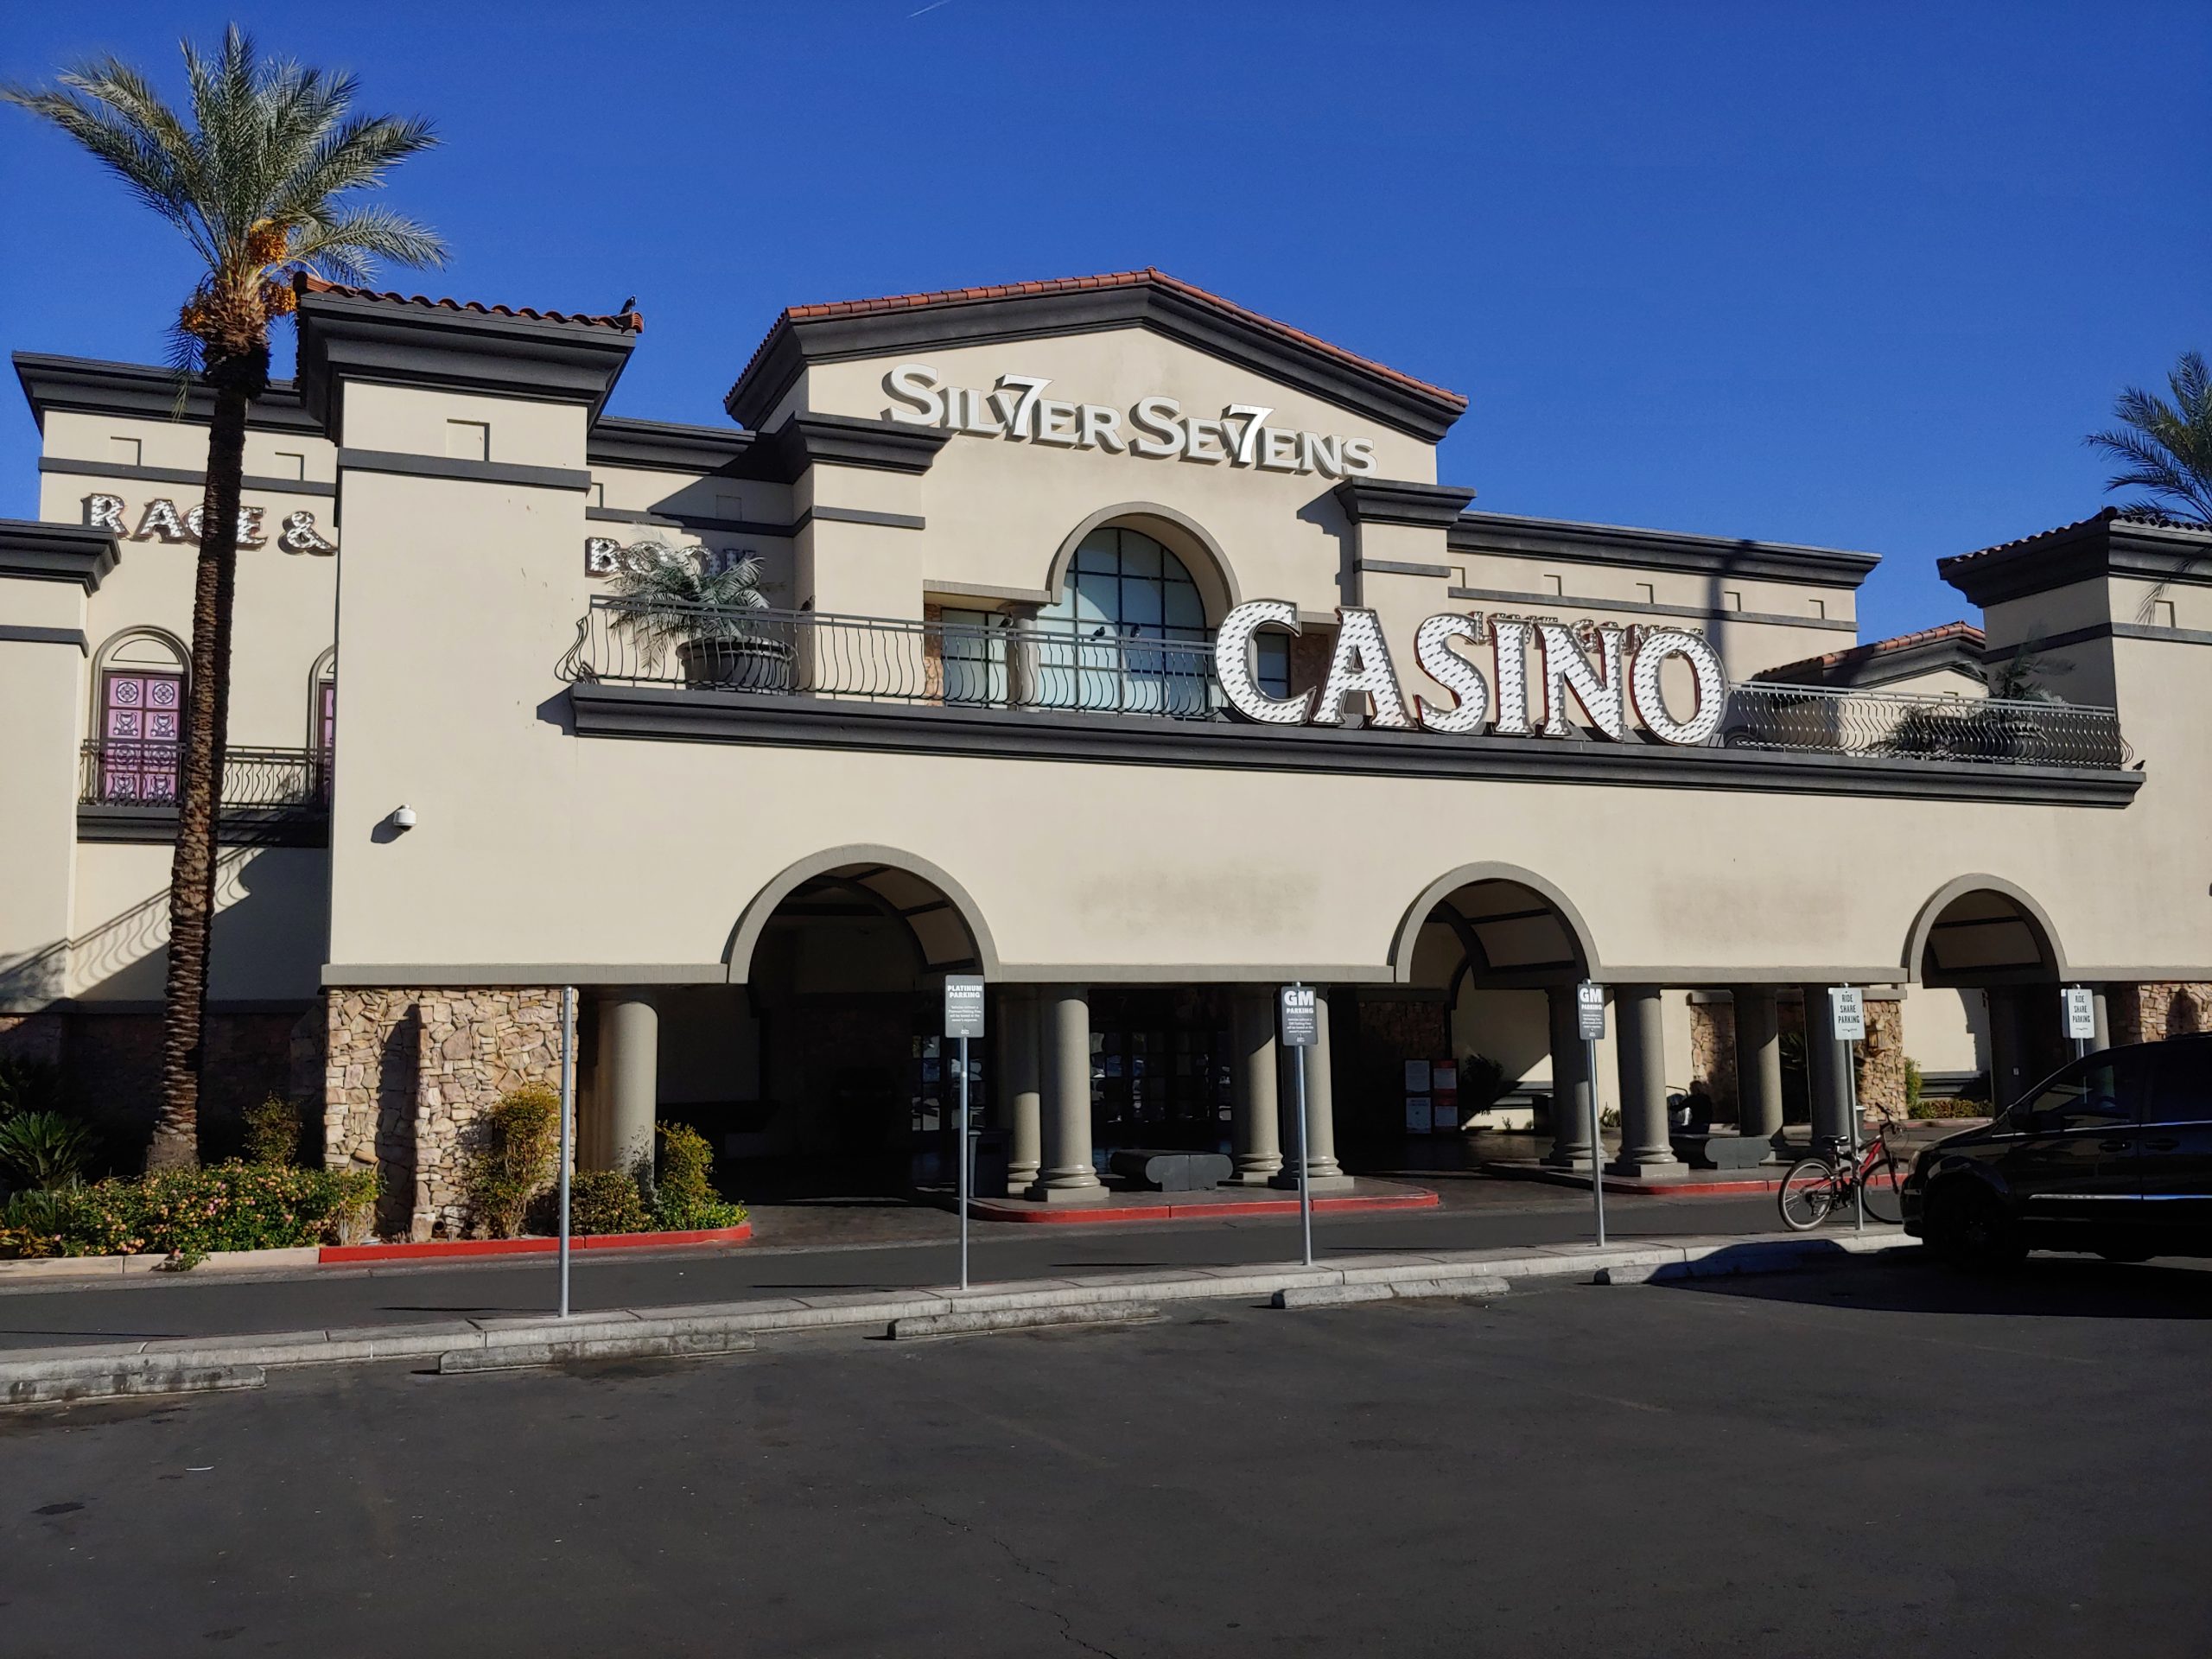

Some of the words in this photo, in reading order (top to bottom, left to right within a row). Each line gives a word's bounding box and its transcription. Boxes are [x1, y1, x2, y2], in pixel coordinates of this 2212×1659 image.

[282, 511, 338, 554] &
[1215, 598, 1728, 746] CASINO
[1284, 990, 1314, 1006] GM
[1580, 988, 1602, 1003] GM
[1841, 994, 1853, 1002] RIDE
[1838, 1015, 1859, 1024] PARKING
